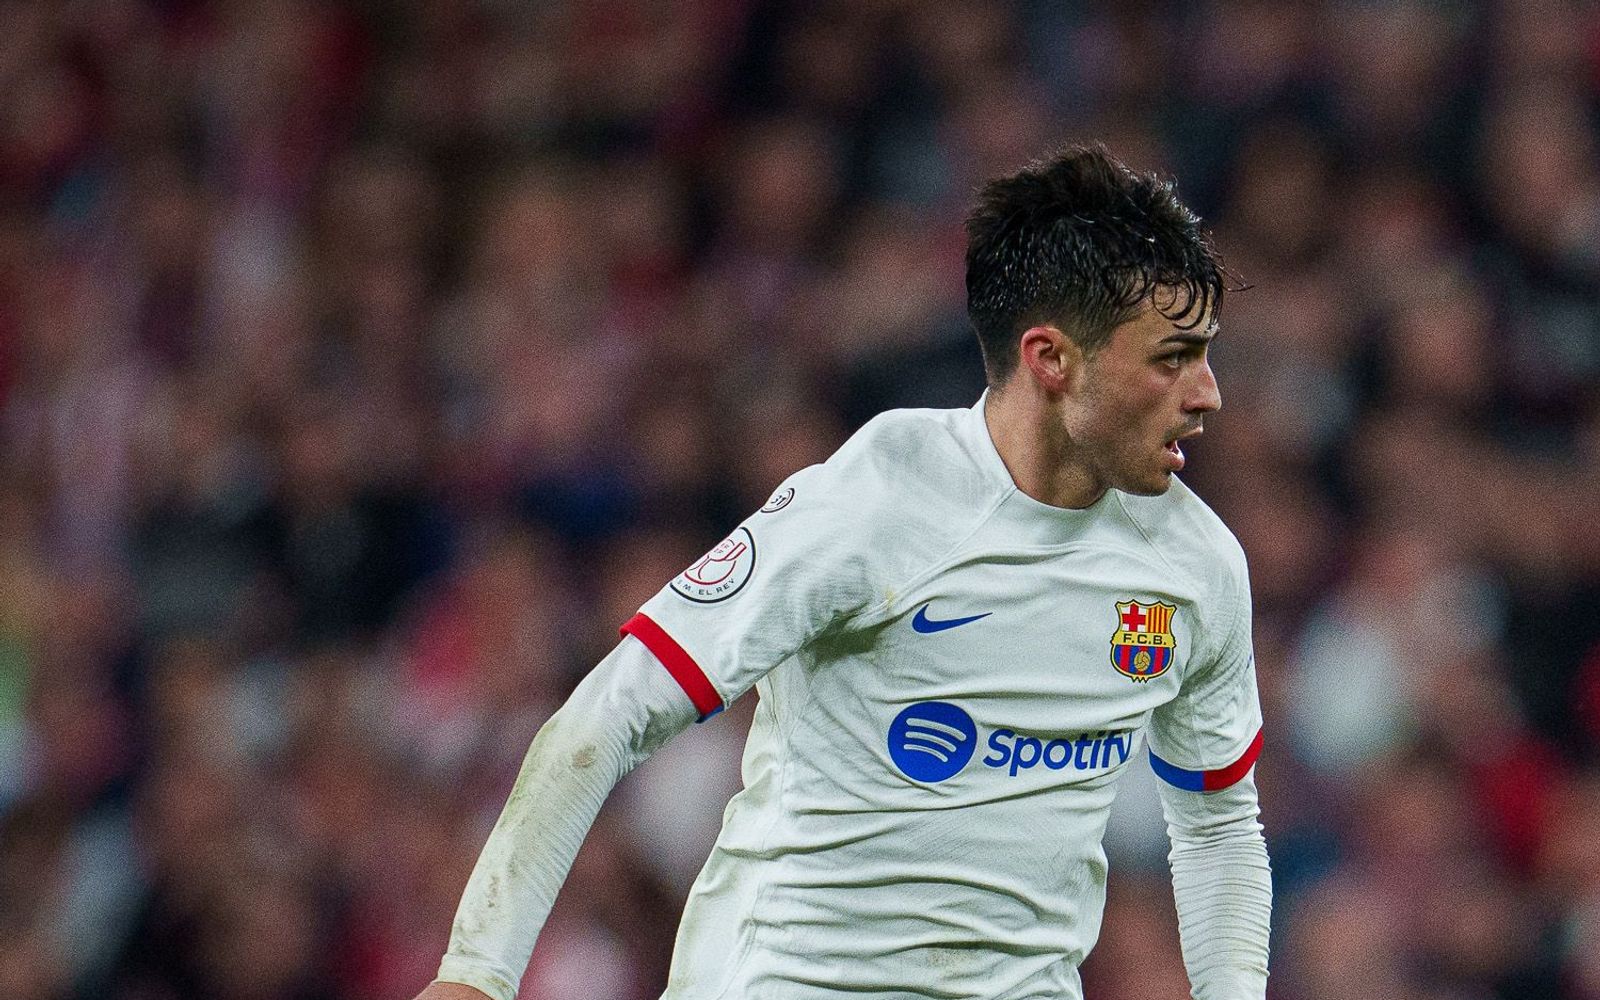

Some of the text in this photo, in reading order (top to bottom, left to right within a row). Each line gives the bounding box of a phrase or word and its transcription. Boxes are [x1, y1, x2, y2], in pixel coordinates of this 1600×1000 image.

[716, 577, 734, 593] REY
[1123, 633, 1167, 646] F.C.B.
[982, 728, 1132, 777] Spotify
